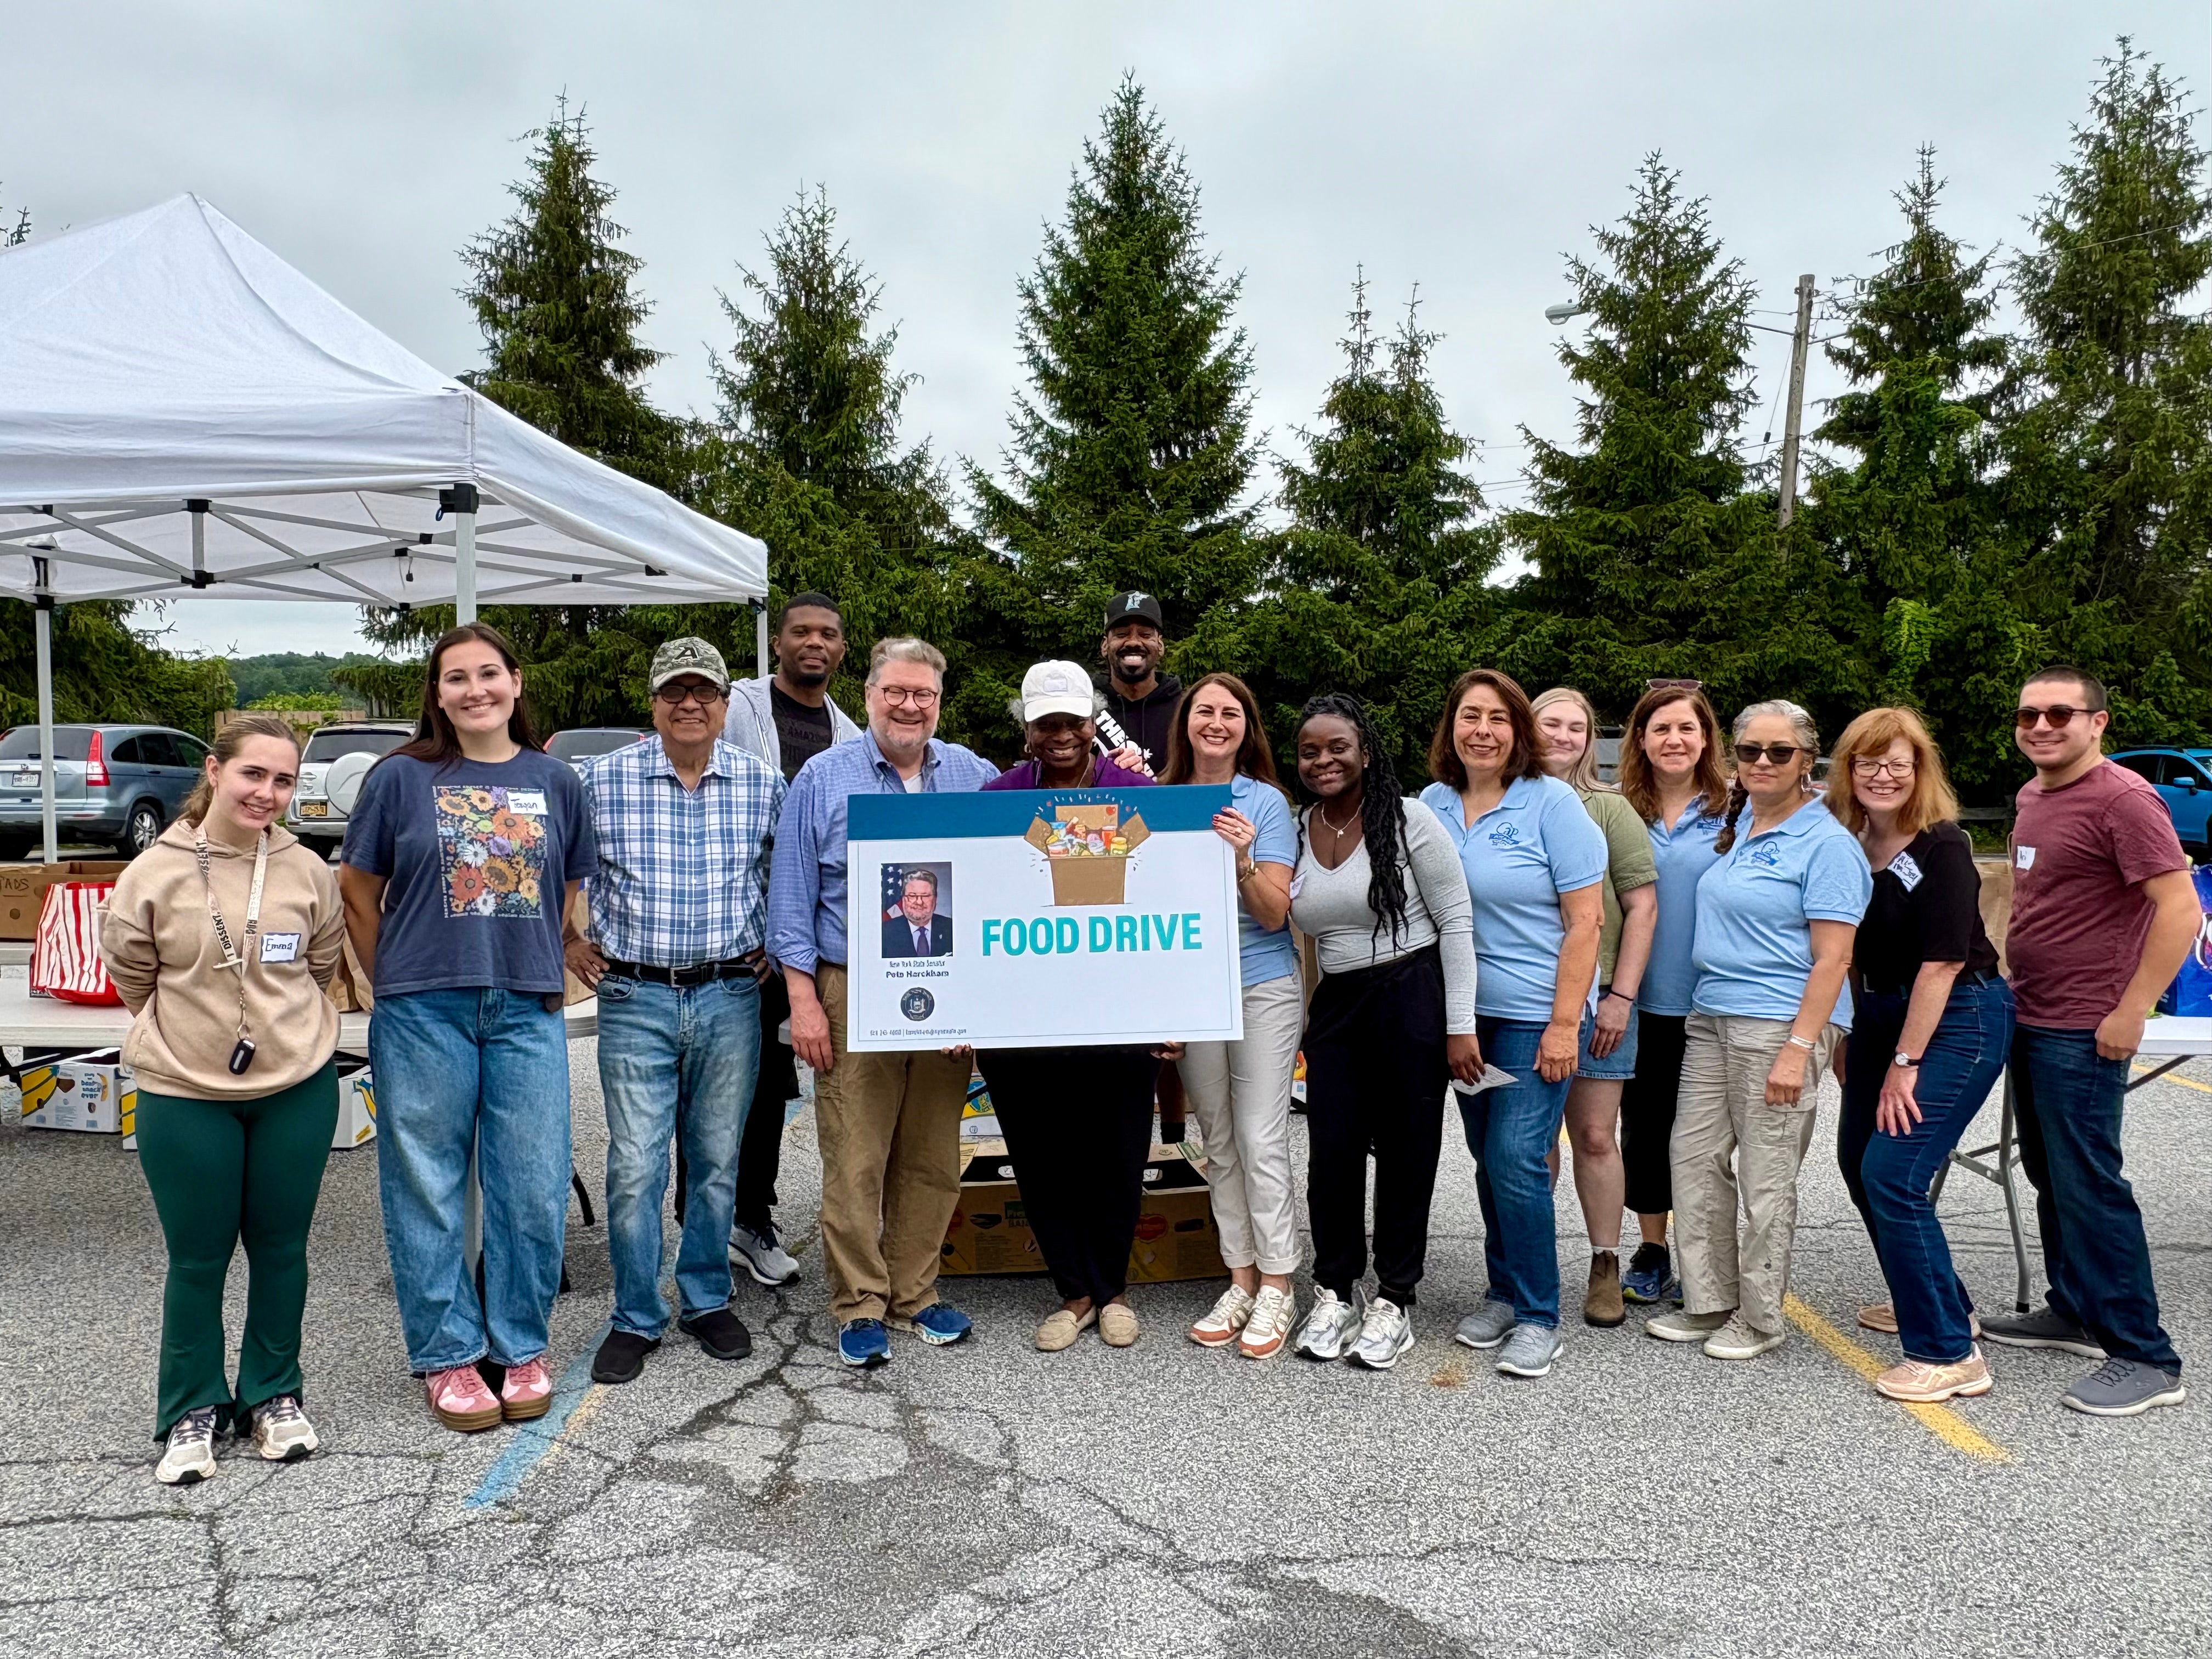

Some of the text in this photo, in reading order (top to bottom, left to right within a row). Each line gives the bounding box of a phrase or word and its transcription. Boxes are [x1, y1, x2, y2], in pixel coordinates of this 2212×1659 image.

[1096, 710, 1128, 747] THE
[265, 938, 292, 952] Emma
[983, 913, 1202, 956] FOOD DRIVE
